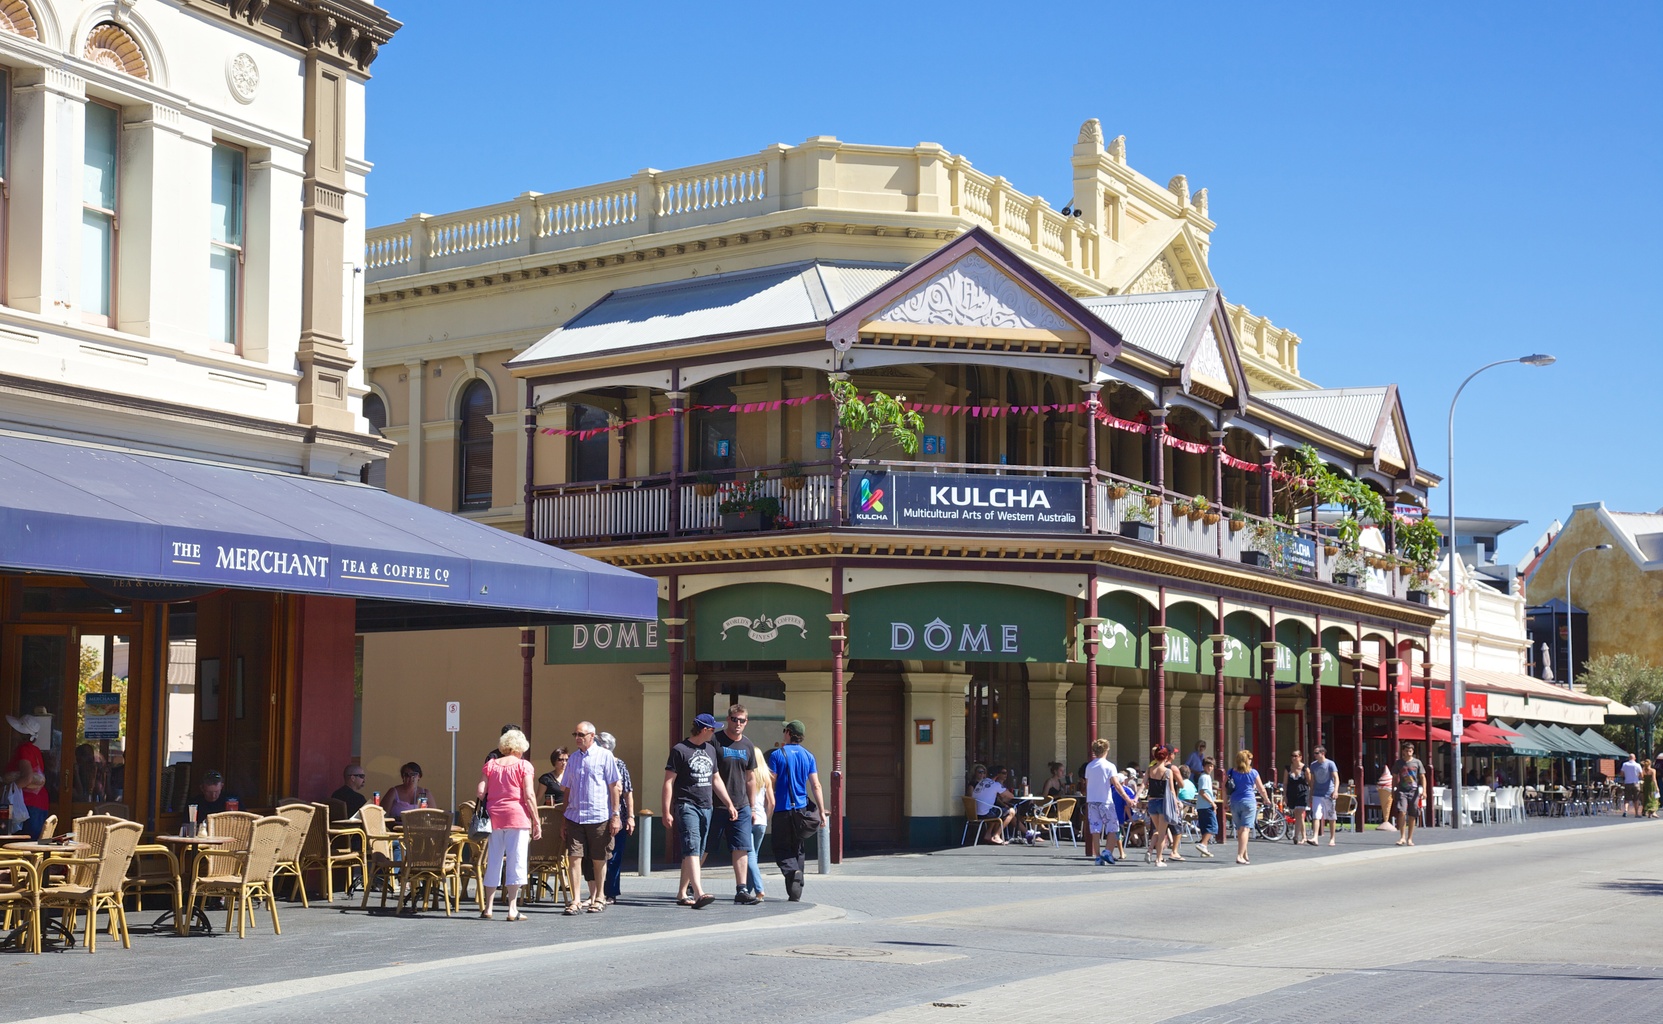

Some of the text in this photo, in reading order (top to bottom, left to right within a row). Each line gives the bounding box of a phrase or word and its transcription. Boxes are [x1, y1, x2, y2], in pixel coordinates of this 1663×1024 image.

[930, 486, 1051, 508] KULCHA
[904, 508, 1076, 523] Multicultural Arts of Western Australia
[172, 541, 200, 558] THE
[215, 546, 329, 578] MERCHANT
[341, 559, 365, 573] TEA
[370, 562, 379, 575] &
[383, 563, 430, 580] COFFEE
[752, 632, 774, 640] FINEST
[777, 616, 801, 625] COFFEES
